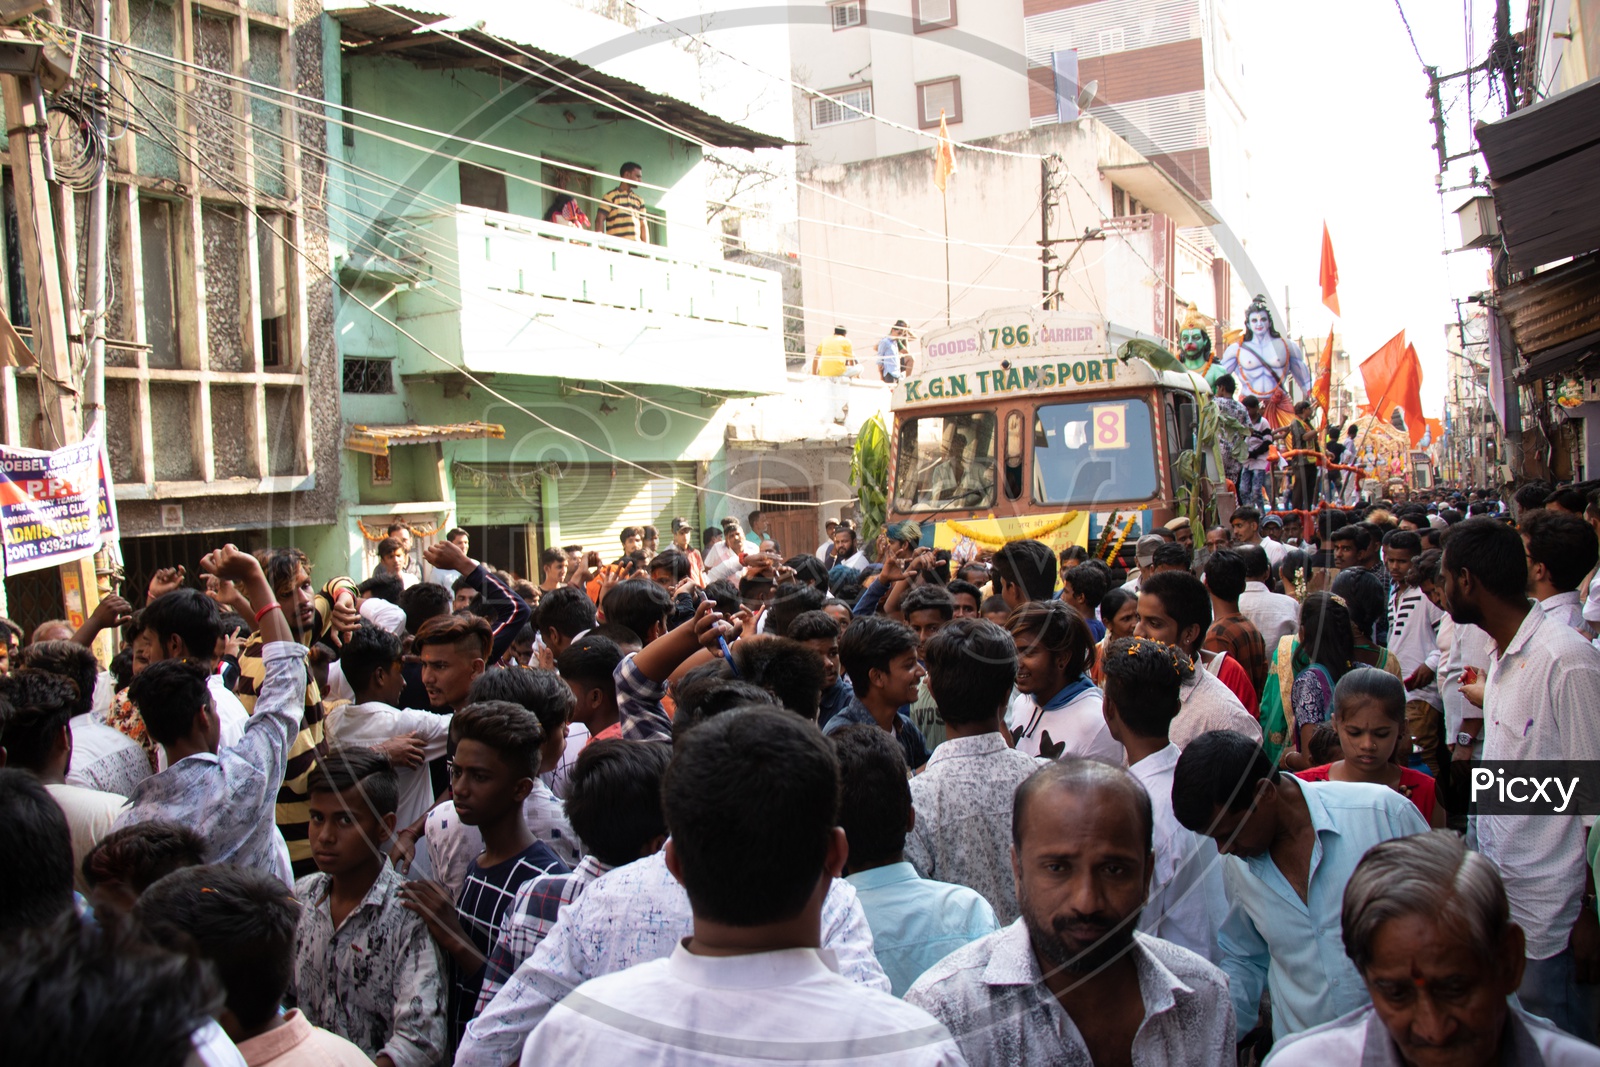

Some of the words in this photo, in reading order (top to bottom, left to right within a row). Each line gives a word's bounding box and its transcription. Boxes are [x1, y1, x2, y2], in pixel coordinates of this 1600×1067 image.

[928, 338, 976, 358] GOODS
[989, 324, 1030, 350] 786
[1040, 326, 1093, 343] CARRIER
[904, 373, 972, 403] K.G.N.
[976, 358, 1118, 396] TRANSPORT
[1096, 410, 1120, 444] 8
